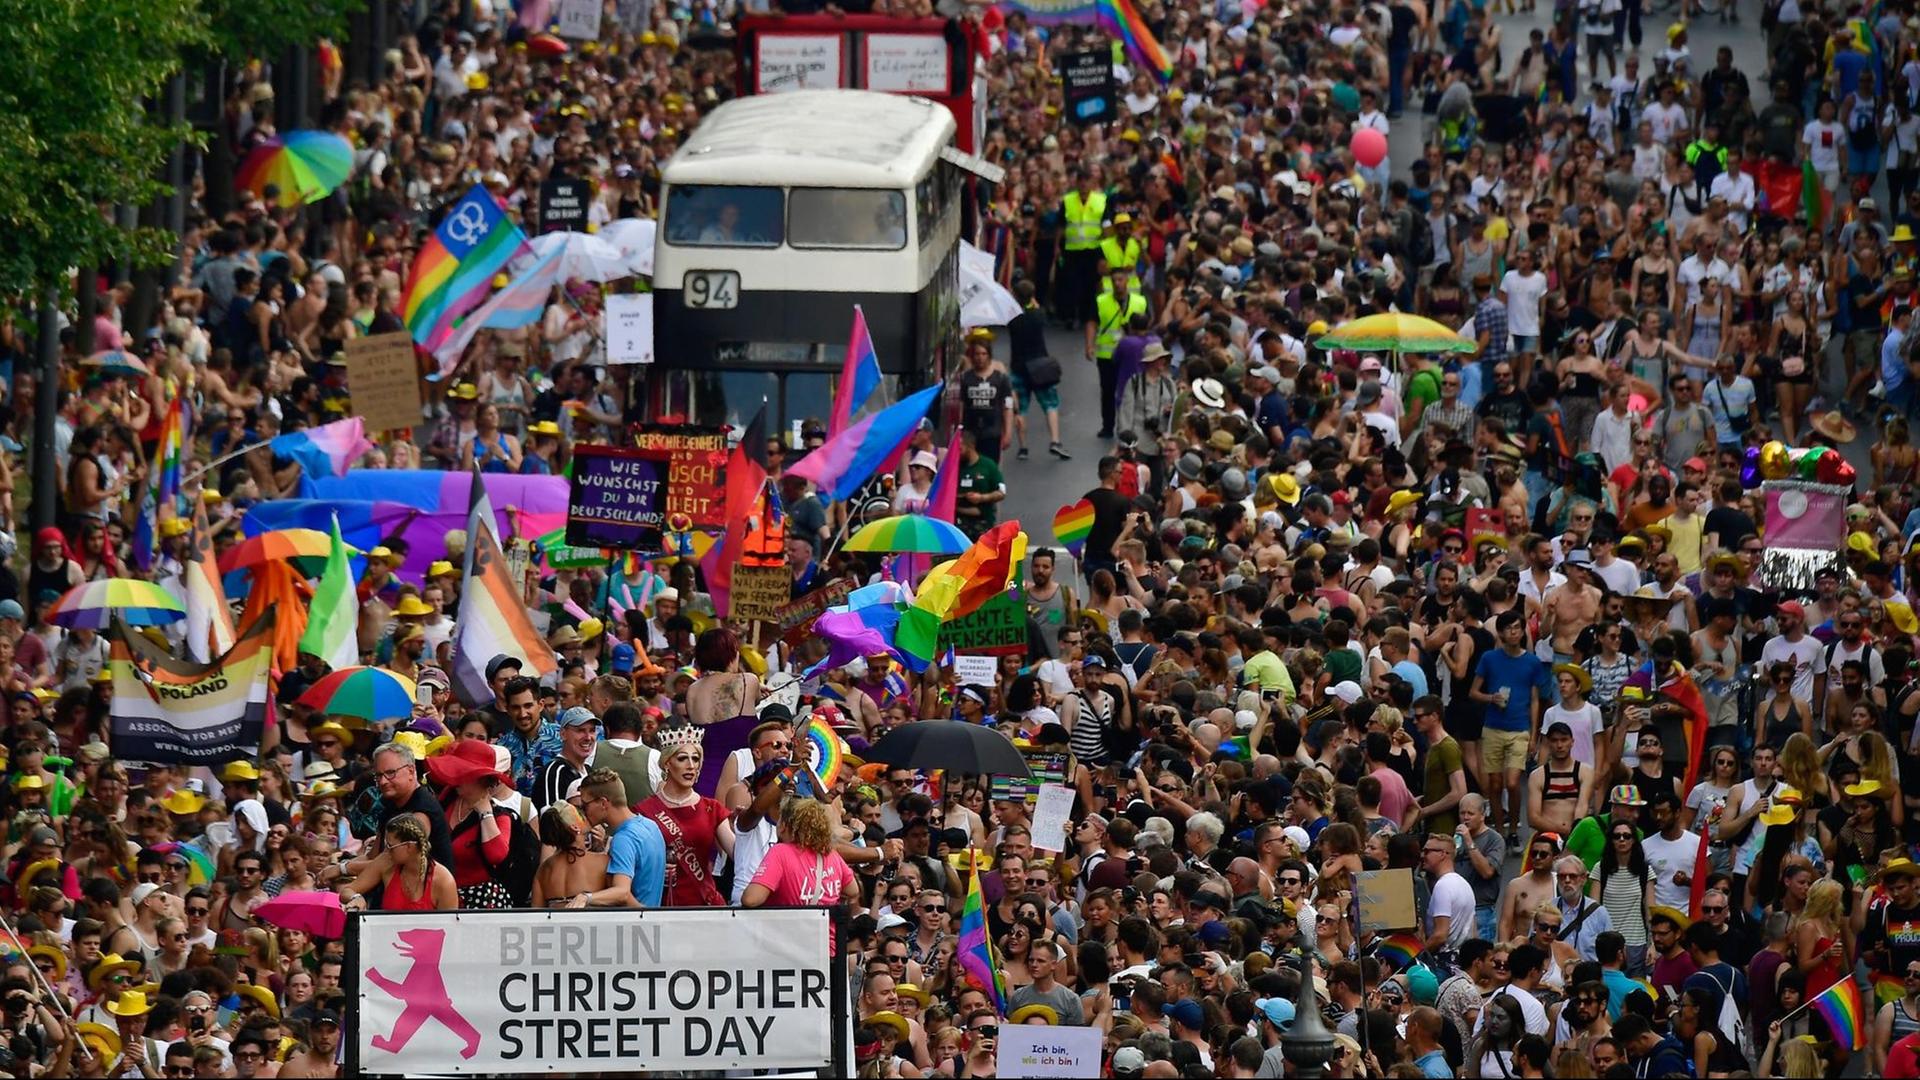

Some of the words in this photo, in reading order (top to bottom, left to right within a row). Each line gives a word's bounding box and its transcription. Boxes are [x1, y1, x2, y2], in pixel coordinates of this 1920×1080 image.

[692, 274, 732, 308] 94
[610, 460, 641, 475] WIE
[578, 473, 661, 494] WÜNSCHST
[602, 491, 621, 503] DU
[627, 494, 647, 506] DIR
[570, 504, 665, 526] DEUTSCHLAND?
[937, 625, 1024, 650] MENSCHEN
[159, 678, 228, 700] POLAND
[193, 730, 216, 744] FOR
[219, 722, 243, 737] MEN
[684, 852, 705, 881] CSD
[810, 866, 835, 878] TAM
[499, 924, 662, 966] BERLIN
[498, 968, 826, 1013] CHRISTOPHER
[499, 1016, 671, 1060] STREET
[684, 1015, 776, 1057] DAY
[1022, 1056, 1037, 1064] wie
[1041, 1056, 1055, 1065] ich
[1058, 1057, 1072, 1066] bin
[1032, 1044, 1048, 1054] Ich
[1052, 1046, 1069, 1056] bin,
